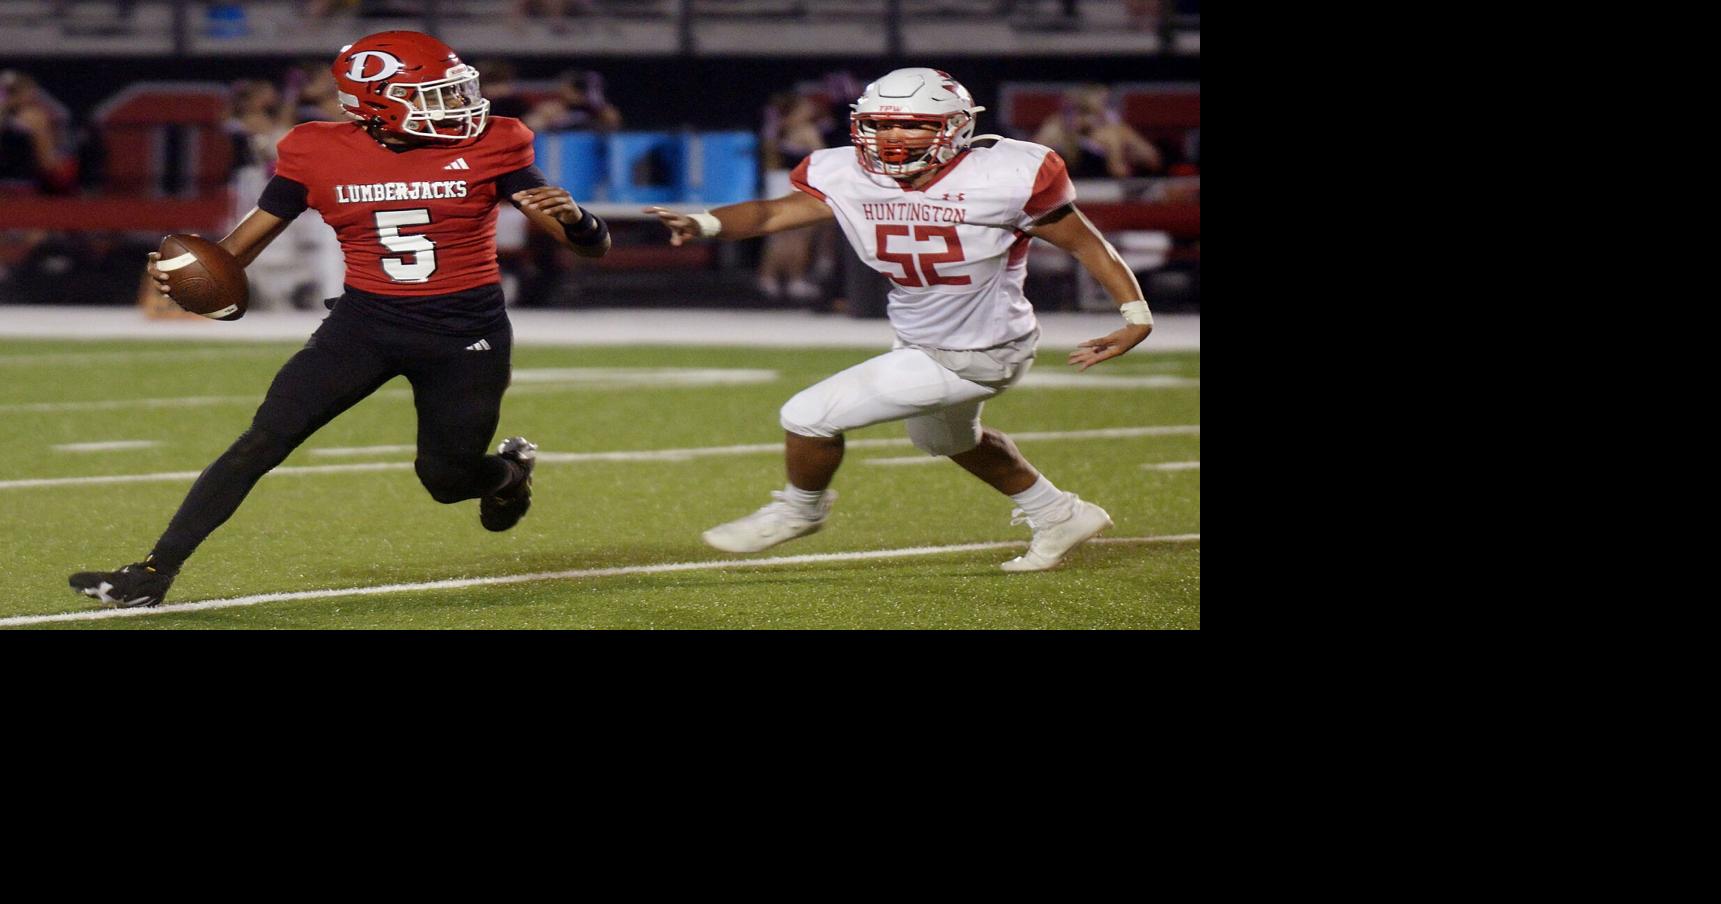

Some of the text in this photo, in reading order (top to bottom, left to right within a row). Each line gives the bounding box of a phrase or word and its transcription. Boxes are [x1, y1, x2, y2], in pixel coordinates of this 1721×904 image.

[345, 50, 406, 83] D
[336, 180, 467, 203] LUMBERJACKS
[862, 203, 965, 223] HUNTINGTON
[374, 208, 437, 283] 5
[876, 224, 972, 287] 52
